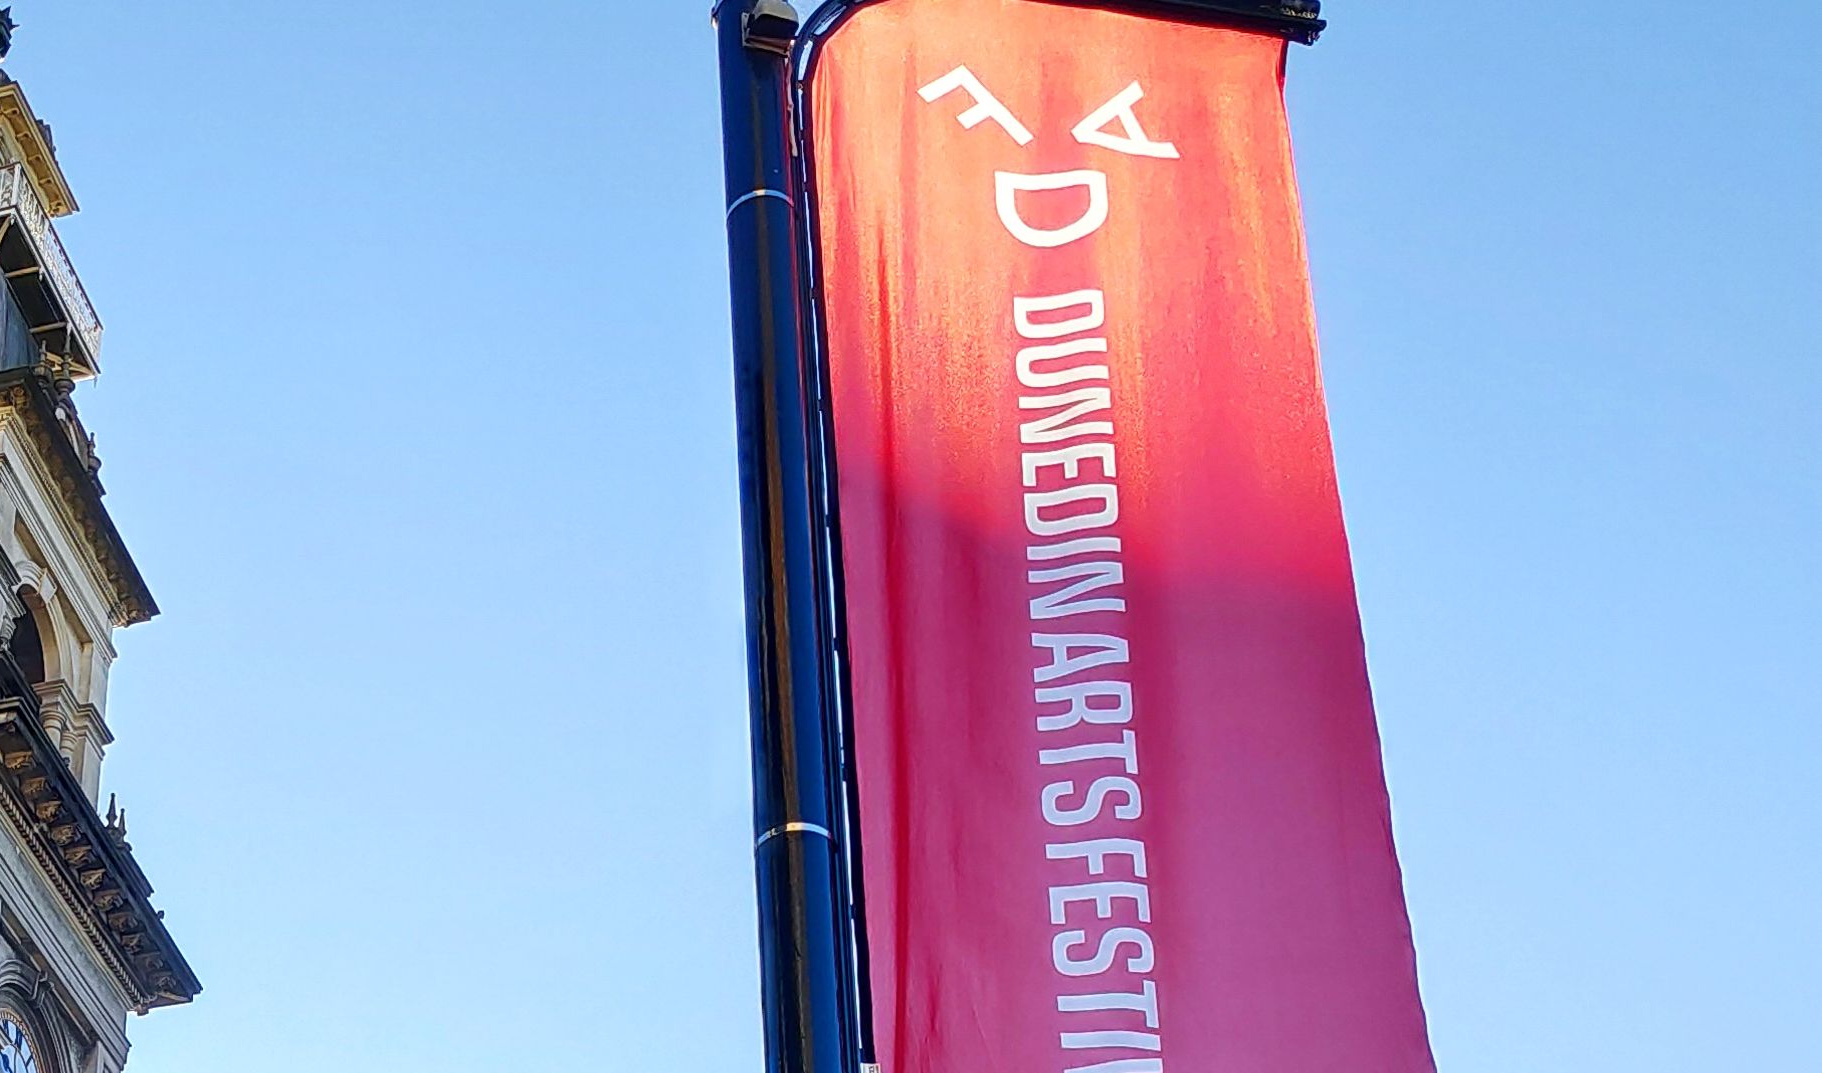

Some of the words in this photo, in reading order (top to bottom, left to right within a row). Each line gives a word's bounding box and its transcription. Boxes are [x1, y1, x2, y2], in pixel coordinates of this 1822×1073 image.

[917, 64, 1033, 147] F
[1070, 80, 1180, 159] A
[994, 168, 1109, 248] D
[1013, 288, 1126, 620] DUNEDIN
[1032, 631, 1142, 826] ARTS
